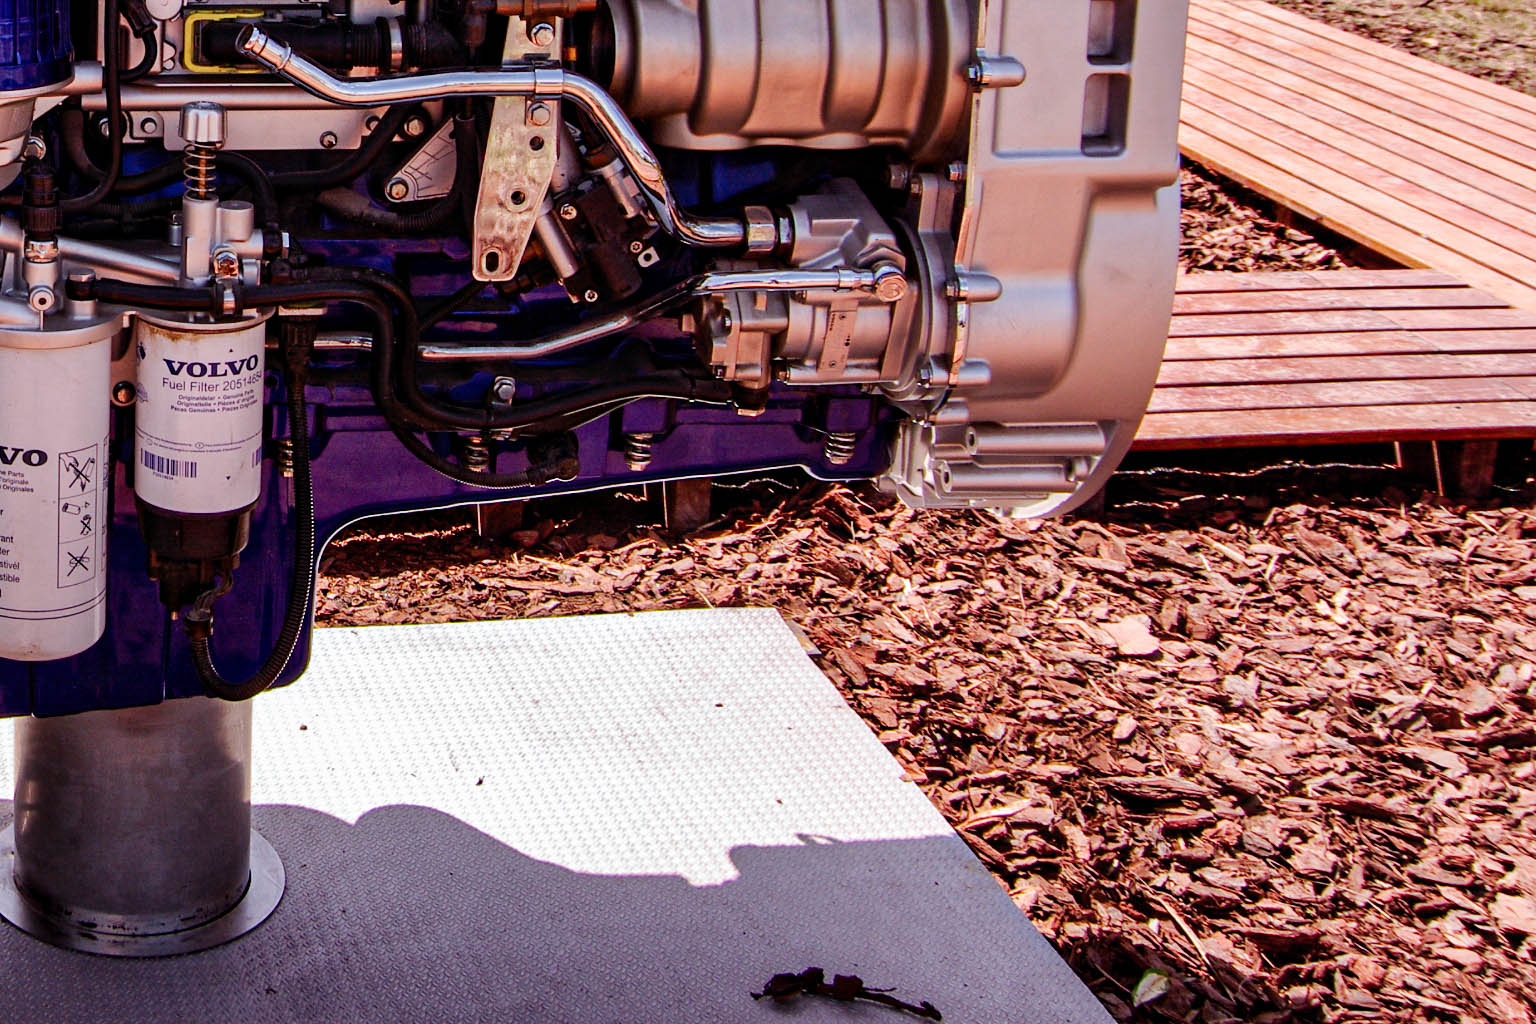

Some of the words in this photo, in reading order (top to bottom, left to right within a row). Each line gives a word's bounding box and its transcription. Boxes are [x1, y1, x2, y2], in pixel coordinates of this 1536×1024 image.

[163, 354, 259, 377] VOLVO
[162, 377, 186, 391] Fuel
[190, 381, 220, 392] Filter
